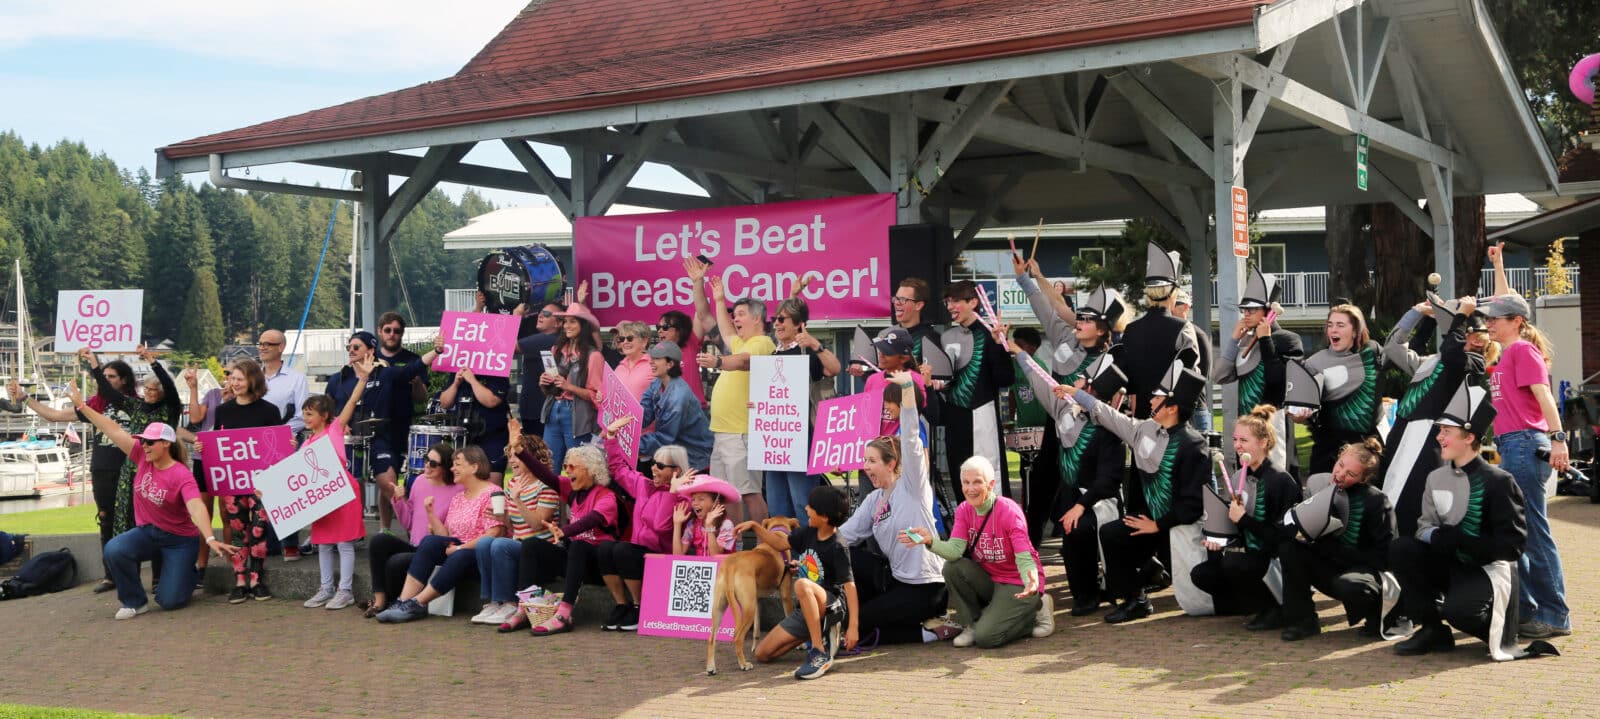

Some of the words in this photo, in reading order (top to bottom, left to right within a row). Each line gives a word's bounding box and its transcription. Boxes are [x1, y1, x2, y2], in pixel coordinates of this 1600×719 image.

[635, 221, 721, 262] Let's
[734, 214, 826, 256] Beat
[591, 272, 710, 309] Breas
[721, 257, 879, 303] Cancer!
[78, 294, 110, 318] Go
[1003, 290, 1029, 305] STO
[62, 319, 134, 349] Vegan
[452, 318, 489, 342] Eat
[437, 343, 508, 371] Plants
[768, 386, 790, 399] Eat
[757, 401, 800, 418] Plants,
[826, 404, 857, 434] Eat
[754, 418, 802, 433] Reduce
[216, 436, 261, 462] Eat
[763, 434, 794, 449] Your
[764, 451, 792, 465] Risk
[287, 473, 308, 492] Go
[270, 471, 347, 524] Plant-Based
